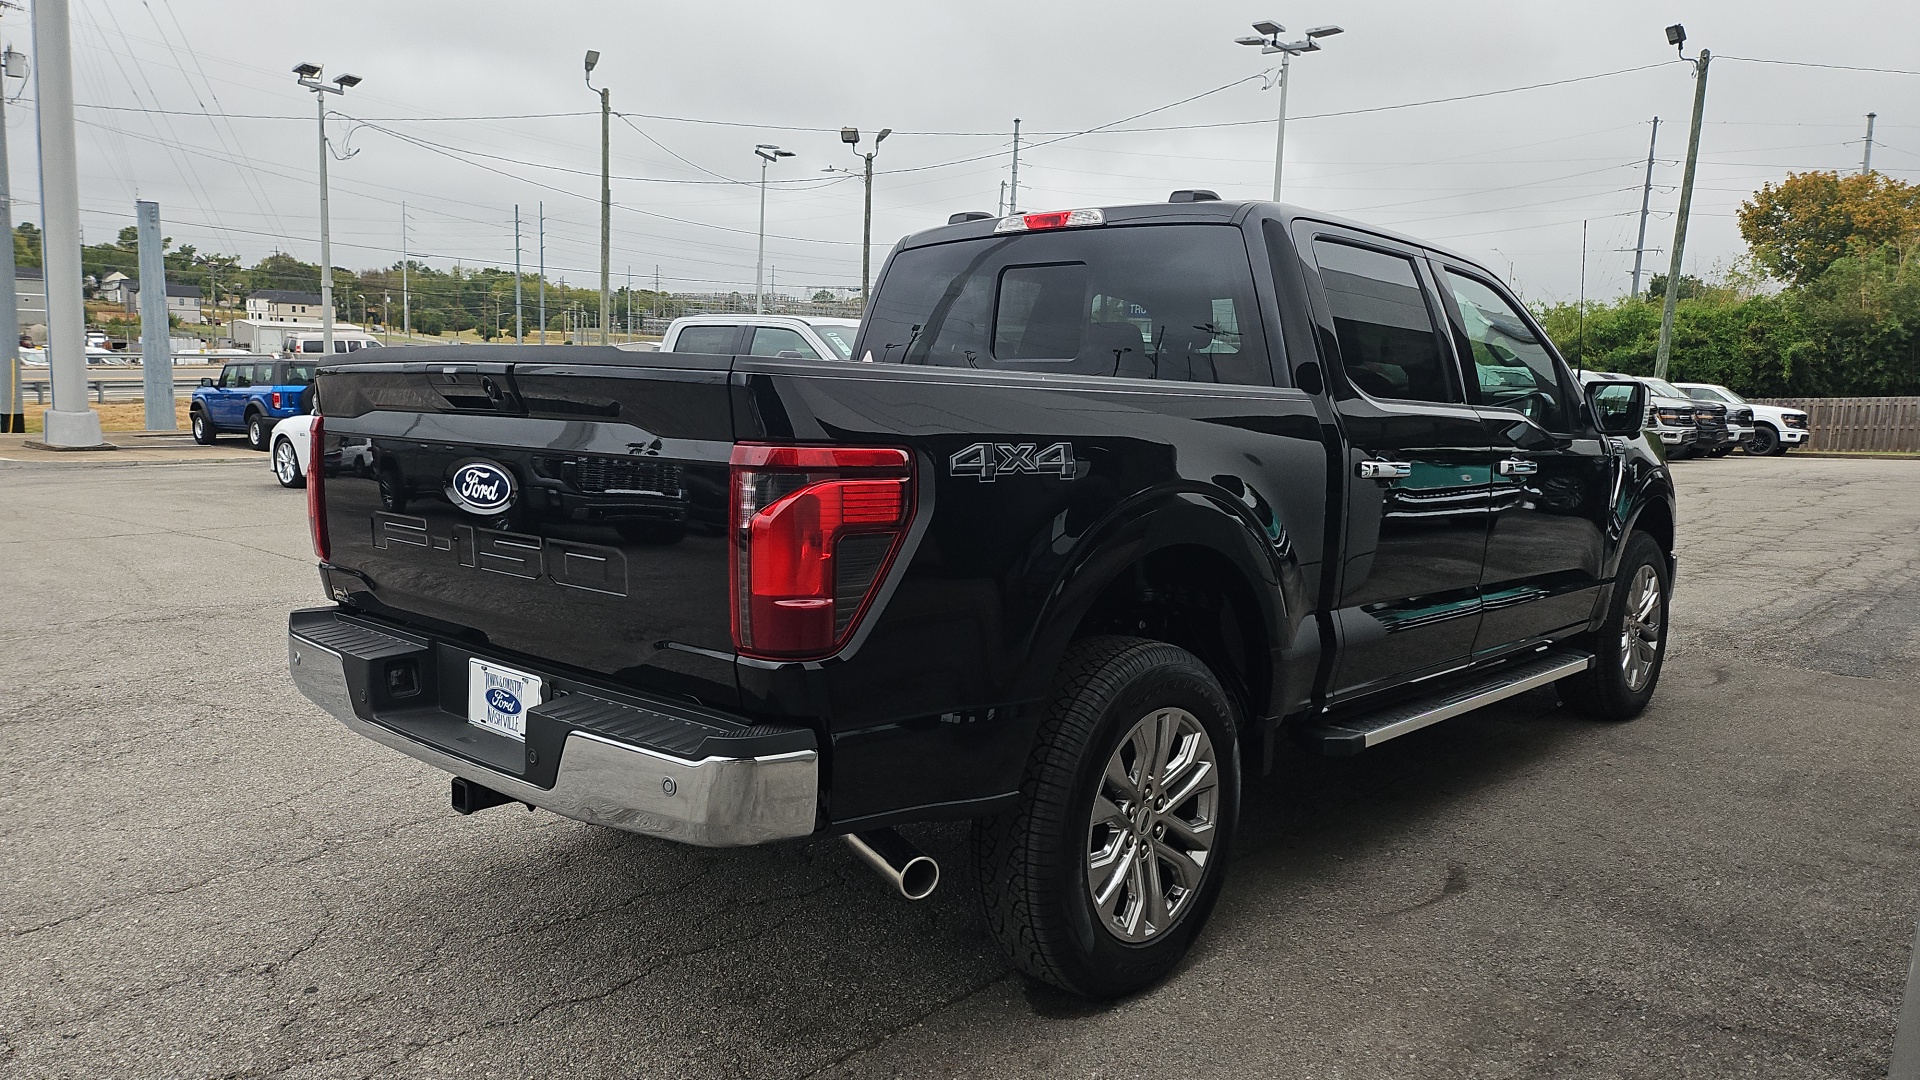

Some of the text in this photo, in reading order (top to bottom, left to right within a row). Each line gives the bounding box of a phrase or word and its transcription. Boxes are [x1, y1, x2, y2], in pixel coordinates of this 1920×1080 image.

[461, 469, 499, 502] Ford
[371, 510, 628, 597] F-150
[491, 689, 516, 713] Ford
[487, 705, 520, 733] NASHVILLE
